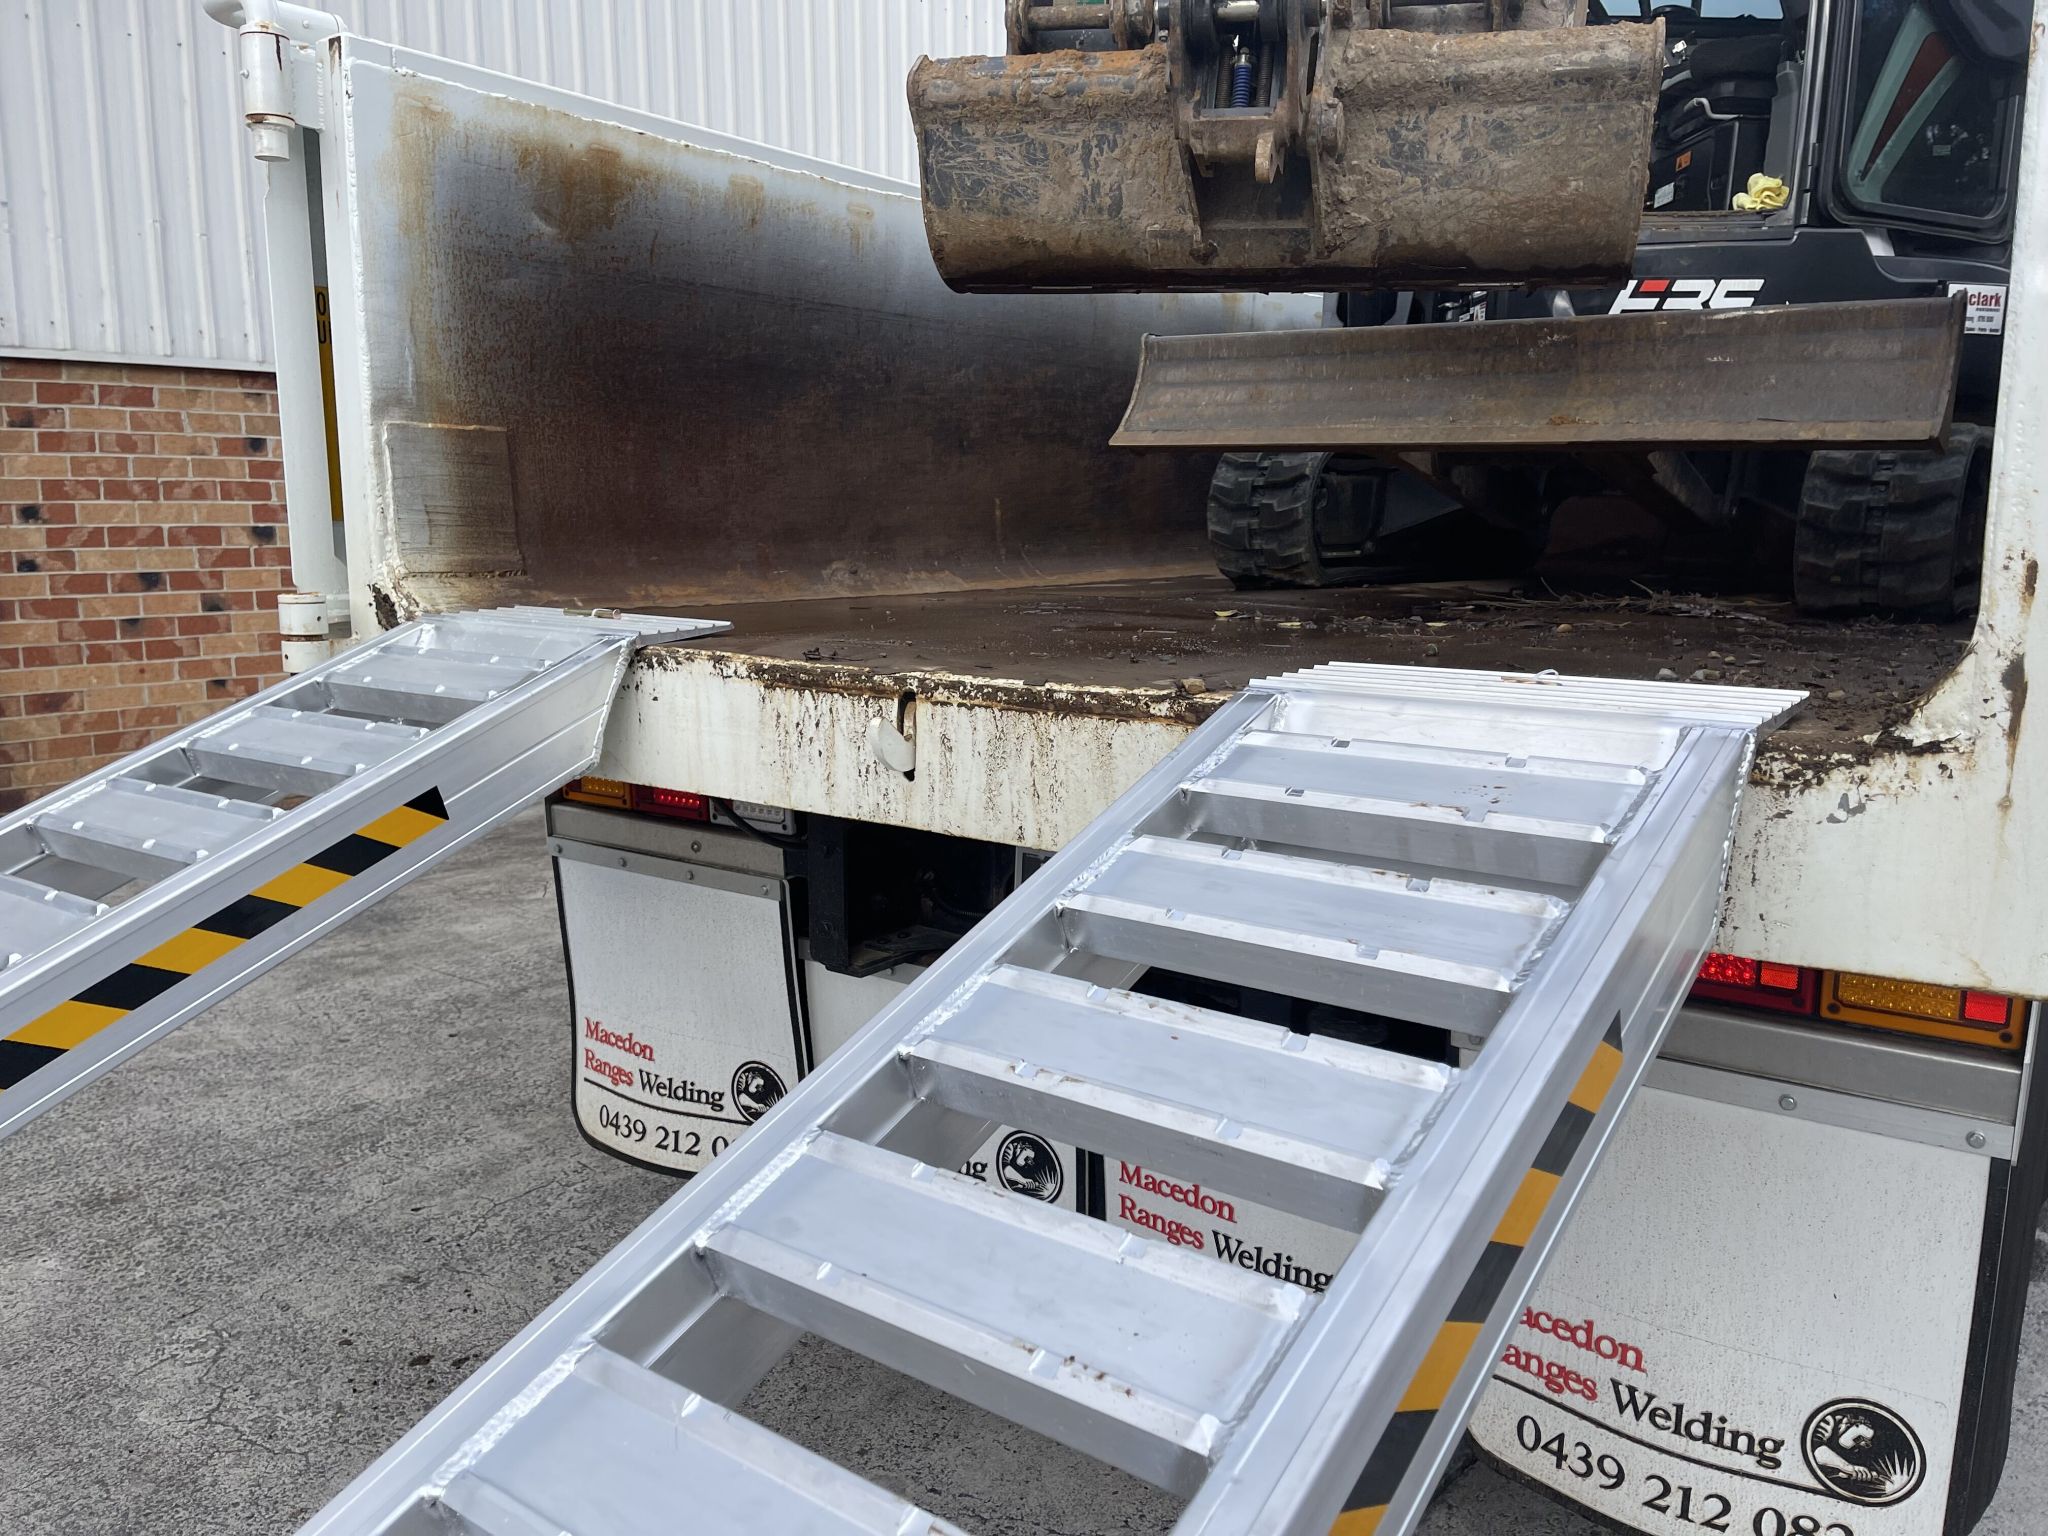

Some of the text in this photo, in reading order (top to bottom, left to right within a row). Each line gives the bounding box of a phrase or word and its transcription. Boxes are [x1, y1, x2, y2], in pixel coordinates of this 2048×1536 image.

[584, 1016, 655, 1063] Macedon
[584, 1047, 725, 1112] Ranges Welding
[599, 1104, 647, 1142] 0439
[655, 1125, 701, 1157] 212
[1118, 1160, 1237, 1223] Macedon
[1118, 1193, 1334, 1293] Ranges Welding
[1519, 1306, 1648, 1374] acedon
[1499, 1344, 1785, 1469] anges Welding
[1516, 1415, 1626, 1490] 0439
[1642, 1474, 1732, 1533] 212
